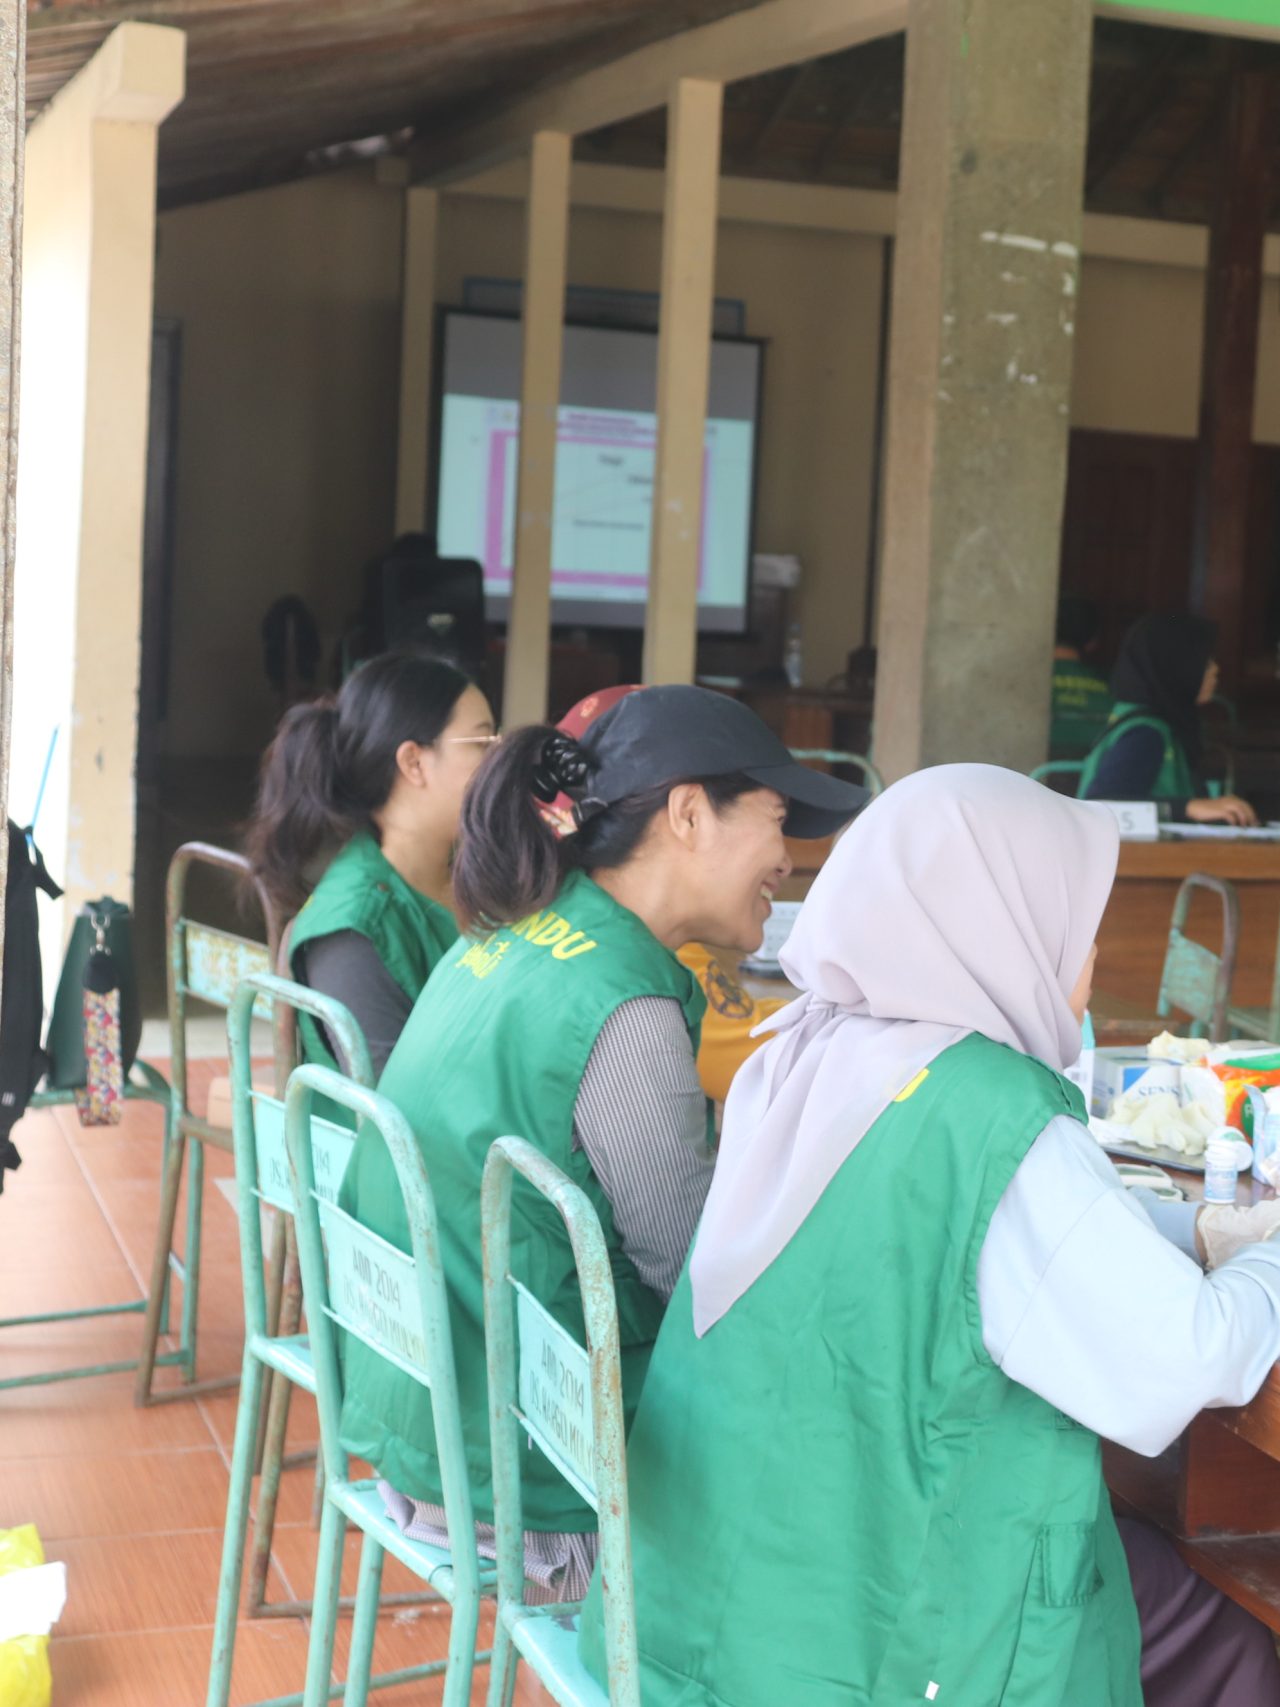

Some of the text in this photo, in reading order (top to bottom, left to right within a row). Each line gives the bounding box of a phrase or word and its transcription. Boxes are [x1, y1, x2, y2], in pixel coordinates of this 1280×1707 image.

[510, 909, 598, 961] NDU
[374, 1261, 402, 1312] 2014
[559, 1360, 585, 1418] 2014
